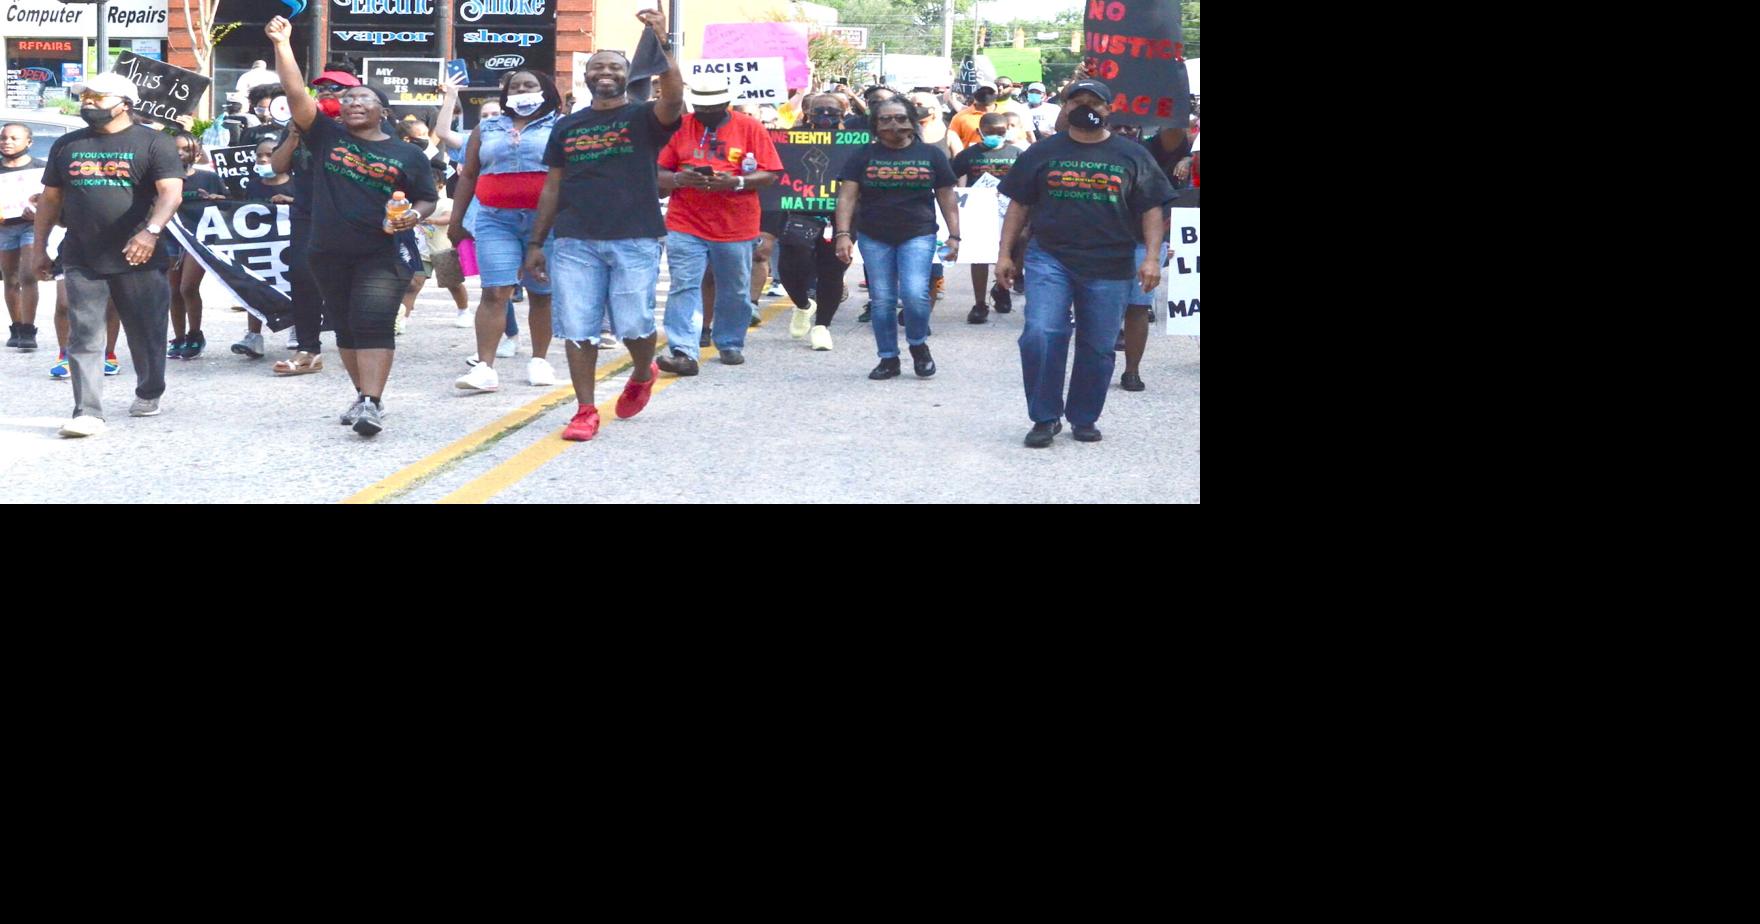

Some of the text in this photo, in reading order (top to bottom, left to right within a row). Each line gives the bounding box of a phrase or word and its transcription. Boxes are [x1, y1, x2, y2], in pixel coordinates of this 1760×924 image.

[7, 4, 167, 27] Computer Repairs
[1088, 0, 1126, 21] NO
[333, 31, 435, 45] vapor
[463, 29, 543, 47] shop
[487, 57, 521, 68] OPEN
[692, 62, 759, 75] RACISM
[18, 68, 50, 81] OPEN
[120, 57, 190, 100] This is
[375, 67, 394, 76] MY
[739, 74, 752, 85] A
[394, 85, 409, 93] IS
[1110, 92, 1173, 118] ACE
[835, 131, 870, 145] 2020
[214, 152, 228, 167] A
[1059, 160, 1079, 168] YOU
[1080, 161, 1107, 169] DON'T
[68, 160, 131, 178] COLOR
[1047, 170, 1122, 193] COLOR
[781, 196, 838, 210] MATTE
